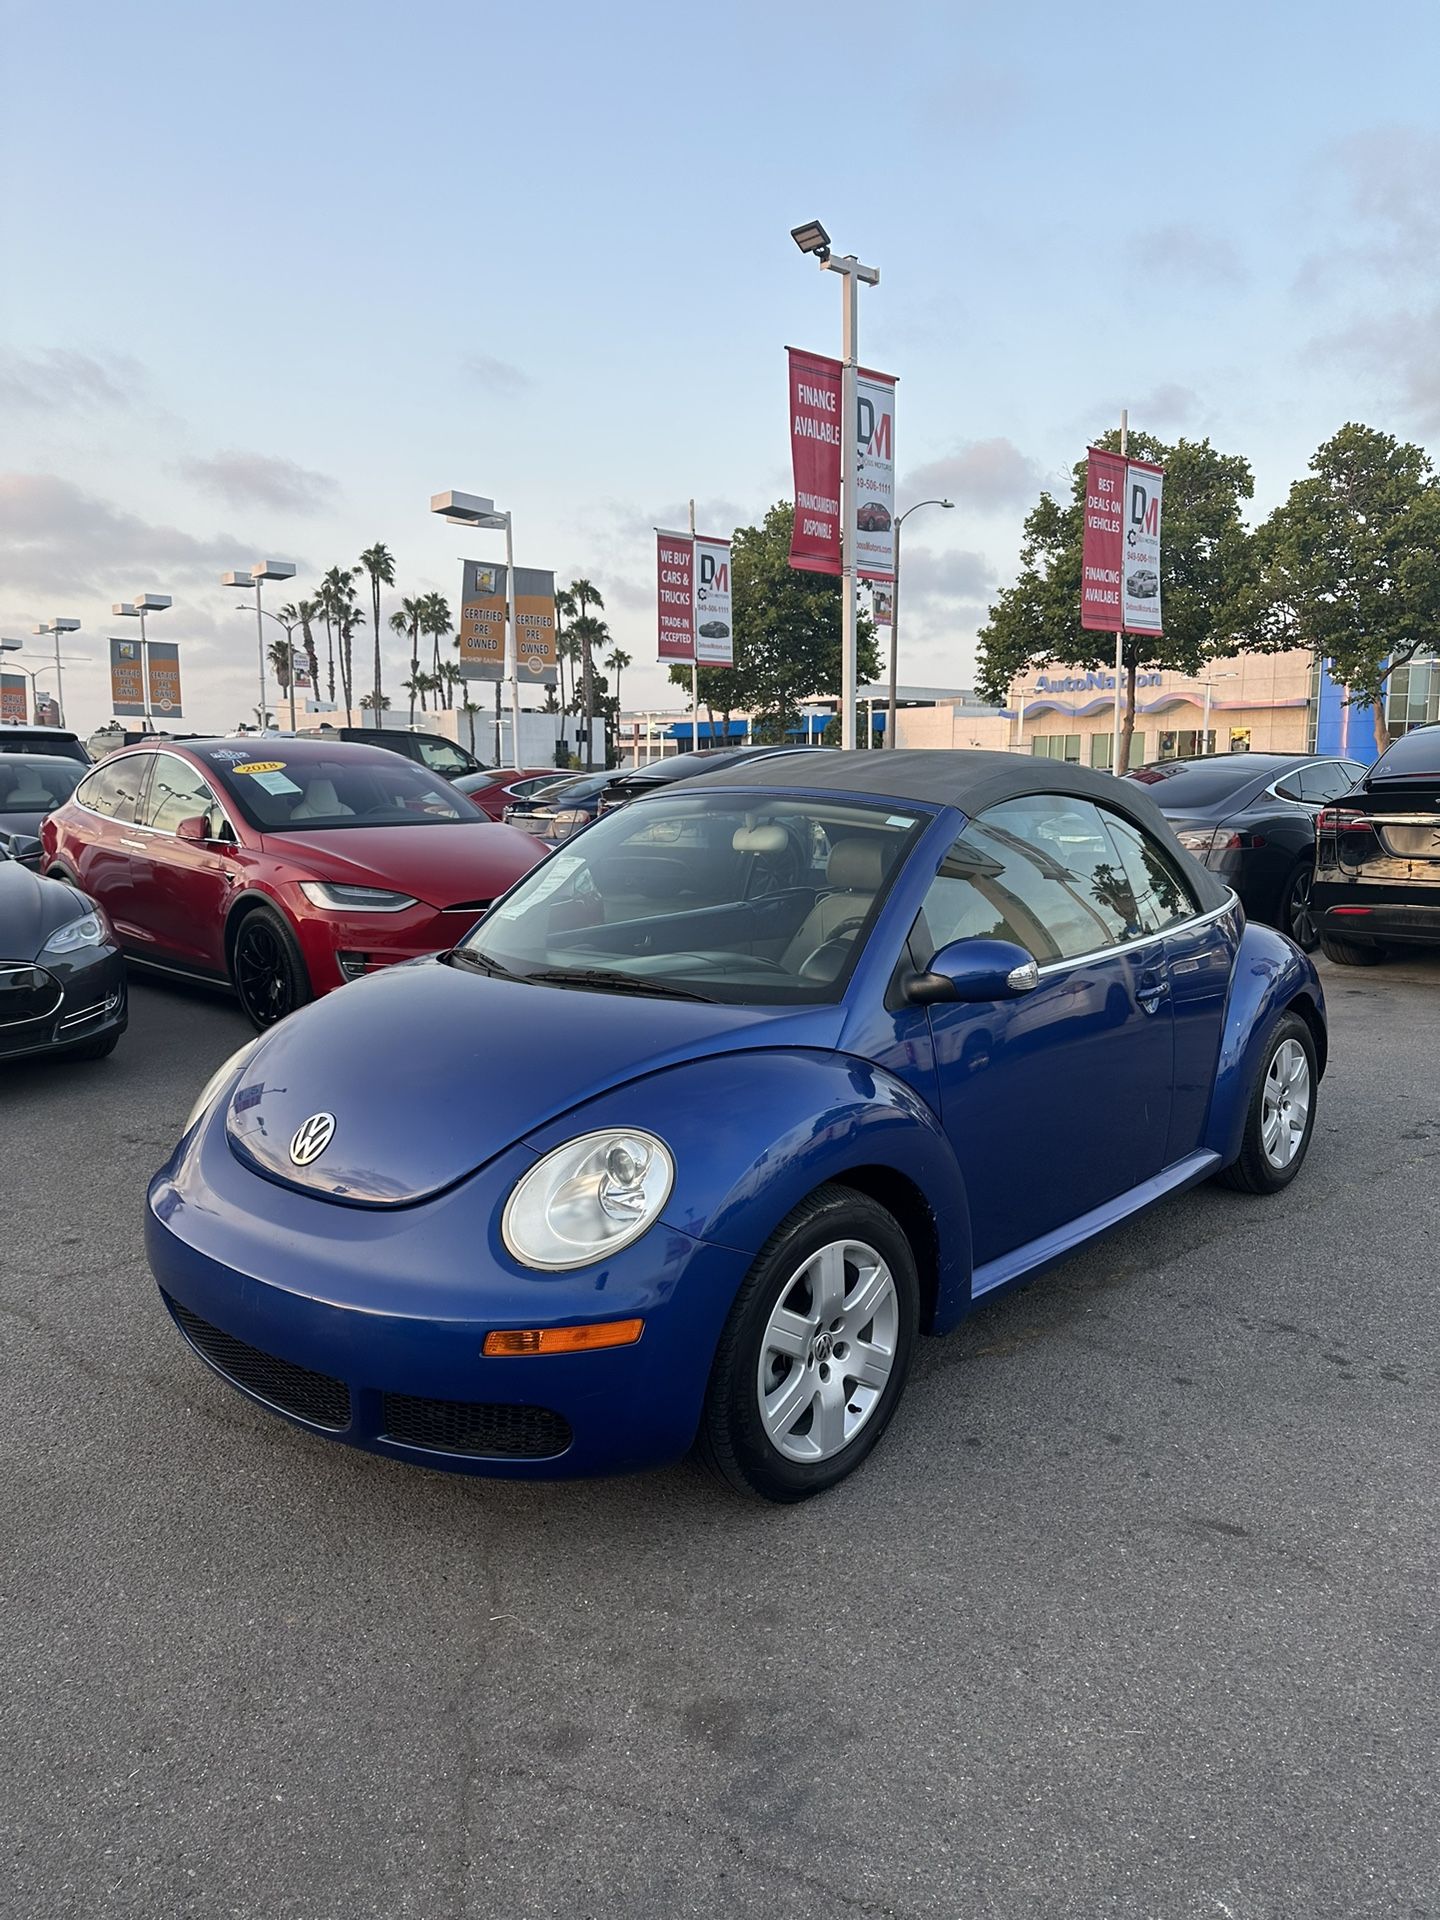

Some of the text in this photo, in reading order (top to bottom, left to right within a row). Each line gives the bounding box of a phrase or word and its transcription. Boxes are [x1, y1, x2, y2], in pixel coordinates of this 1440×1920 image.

[798, 383, 836, 412] FINANCE
[794, 415, 840, 446] AVAILABLE
[1098, 478, 1114, 493] BEST
[797, 491, 838, 516] FINANCIAMIENTO
[1088, 495, 1121, 514] DEALS ON
[803, 518, 832, 539] DISPONIBLE
[1088, 515, 1120, 533] VEHICLES
[660, 550, 691, 566] WE BUY
[661, 570, 689, 586] CARS &
[1085, 567, 1120, 584] FINANCING
[660, 589, 690, 605] TRUCKS
[1085, 588, 1119, 605] AVAILABLE
[464, 608, 503, 622] CERTIFIED
[515, 614, 552, 627] CERTIFIED
[661, 616, 690, 629] TRADE-IN
[474, 624, 491, 635] PRE-
[467, 638, 498, 650] OWNED
[660, 631, 691, 644] ACCEPTED
[520, 643, 549, 655] OWNED
[112, 669, 141, 678] CERTIFIED
[151, 672, 177, 680] CERTIFIED
[1035, 672, 1162, 694] AutoNaton
[116, 688, 139, 696] OWNED
[154, 690, 177, 698] OWNED
[243, 763, 278, 772] 2018
